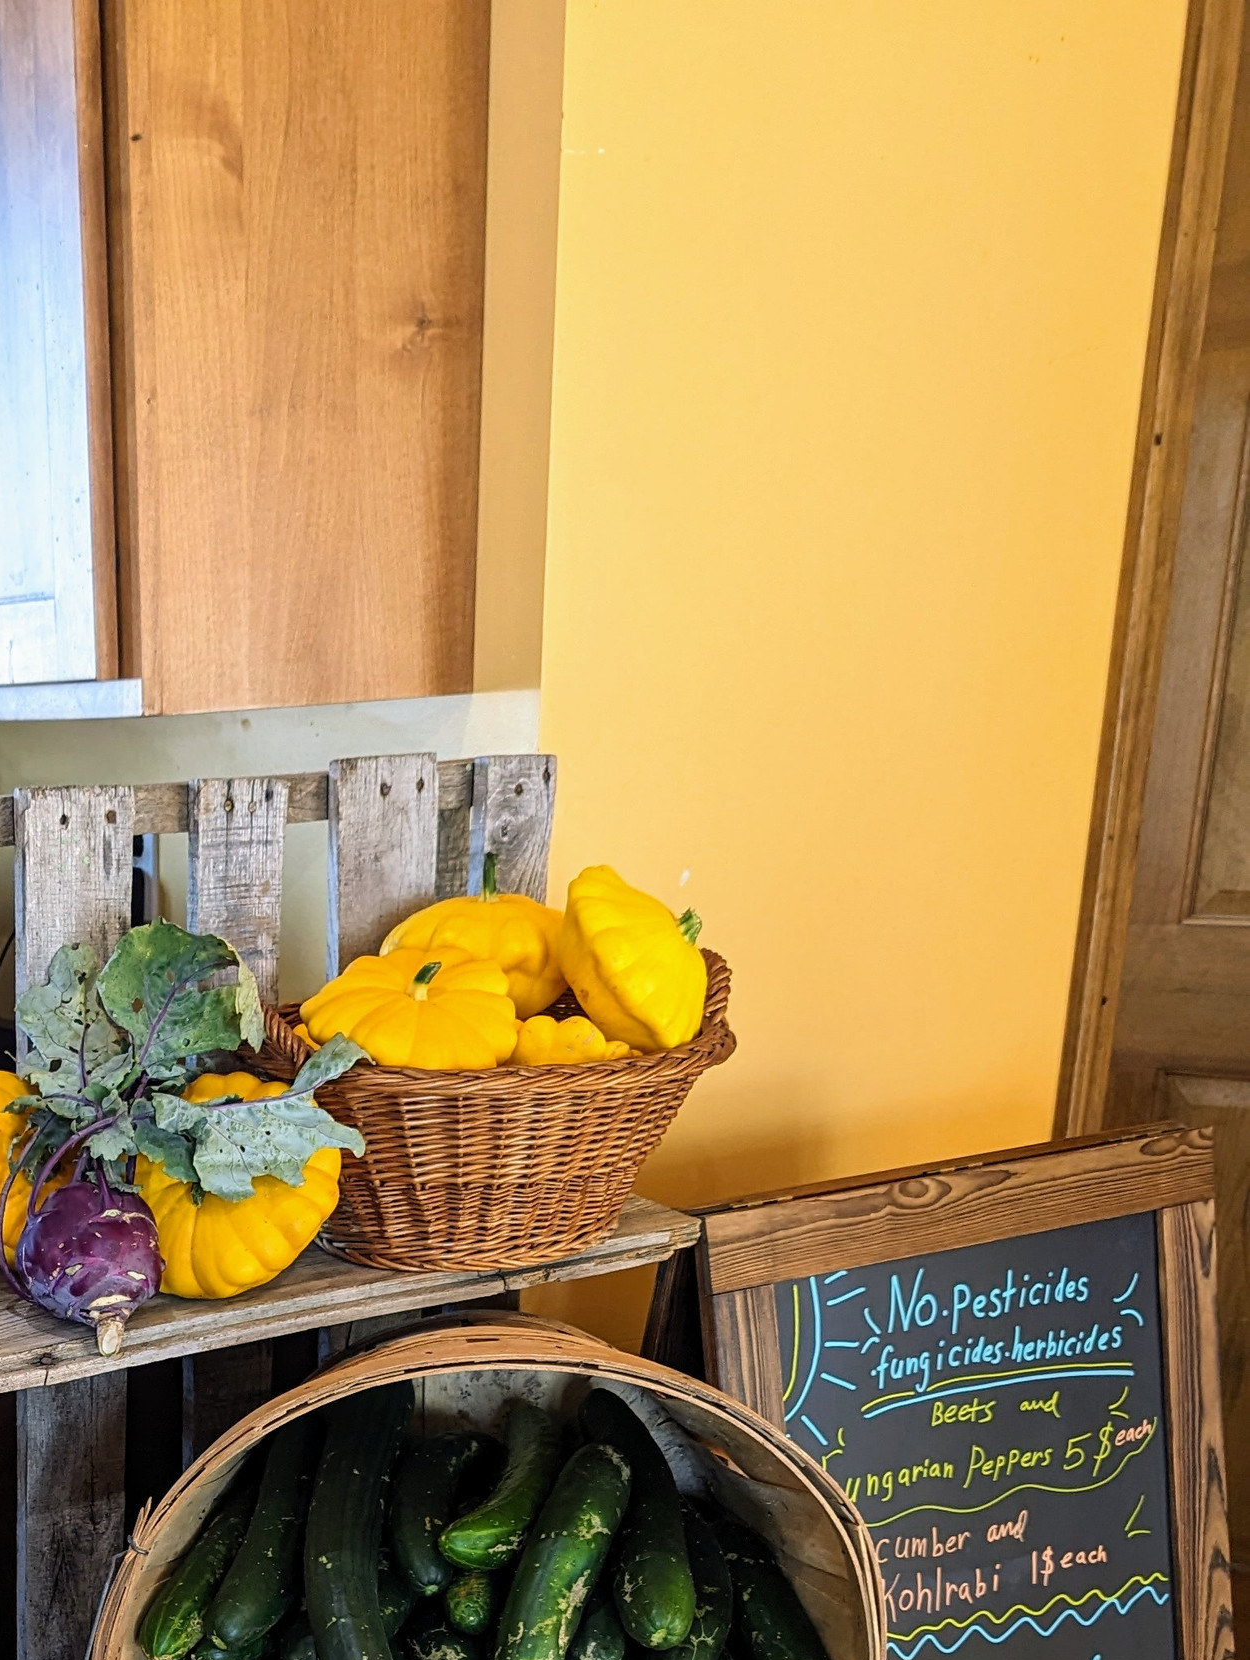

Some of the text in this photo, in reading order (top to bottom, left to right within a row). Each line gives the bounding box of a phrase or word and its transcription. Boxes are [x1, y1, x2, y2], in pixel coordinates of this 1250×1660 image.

[930, 1391, 1061, 1427] Beets and
[845, 1457, 955, 1502] ungarian
[874, 1510, 1029, 1563] cumber and
[882, 1563, 1001, 1623] Kohlrabi
